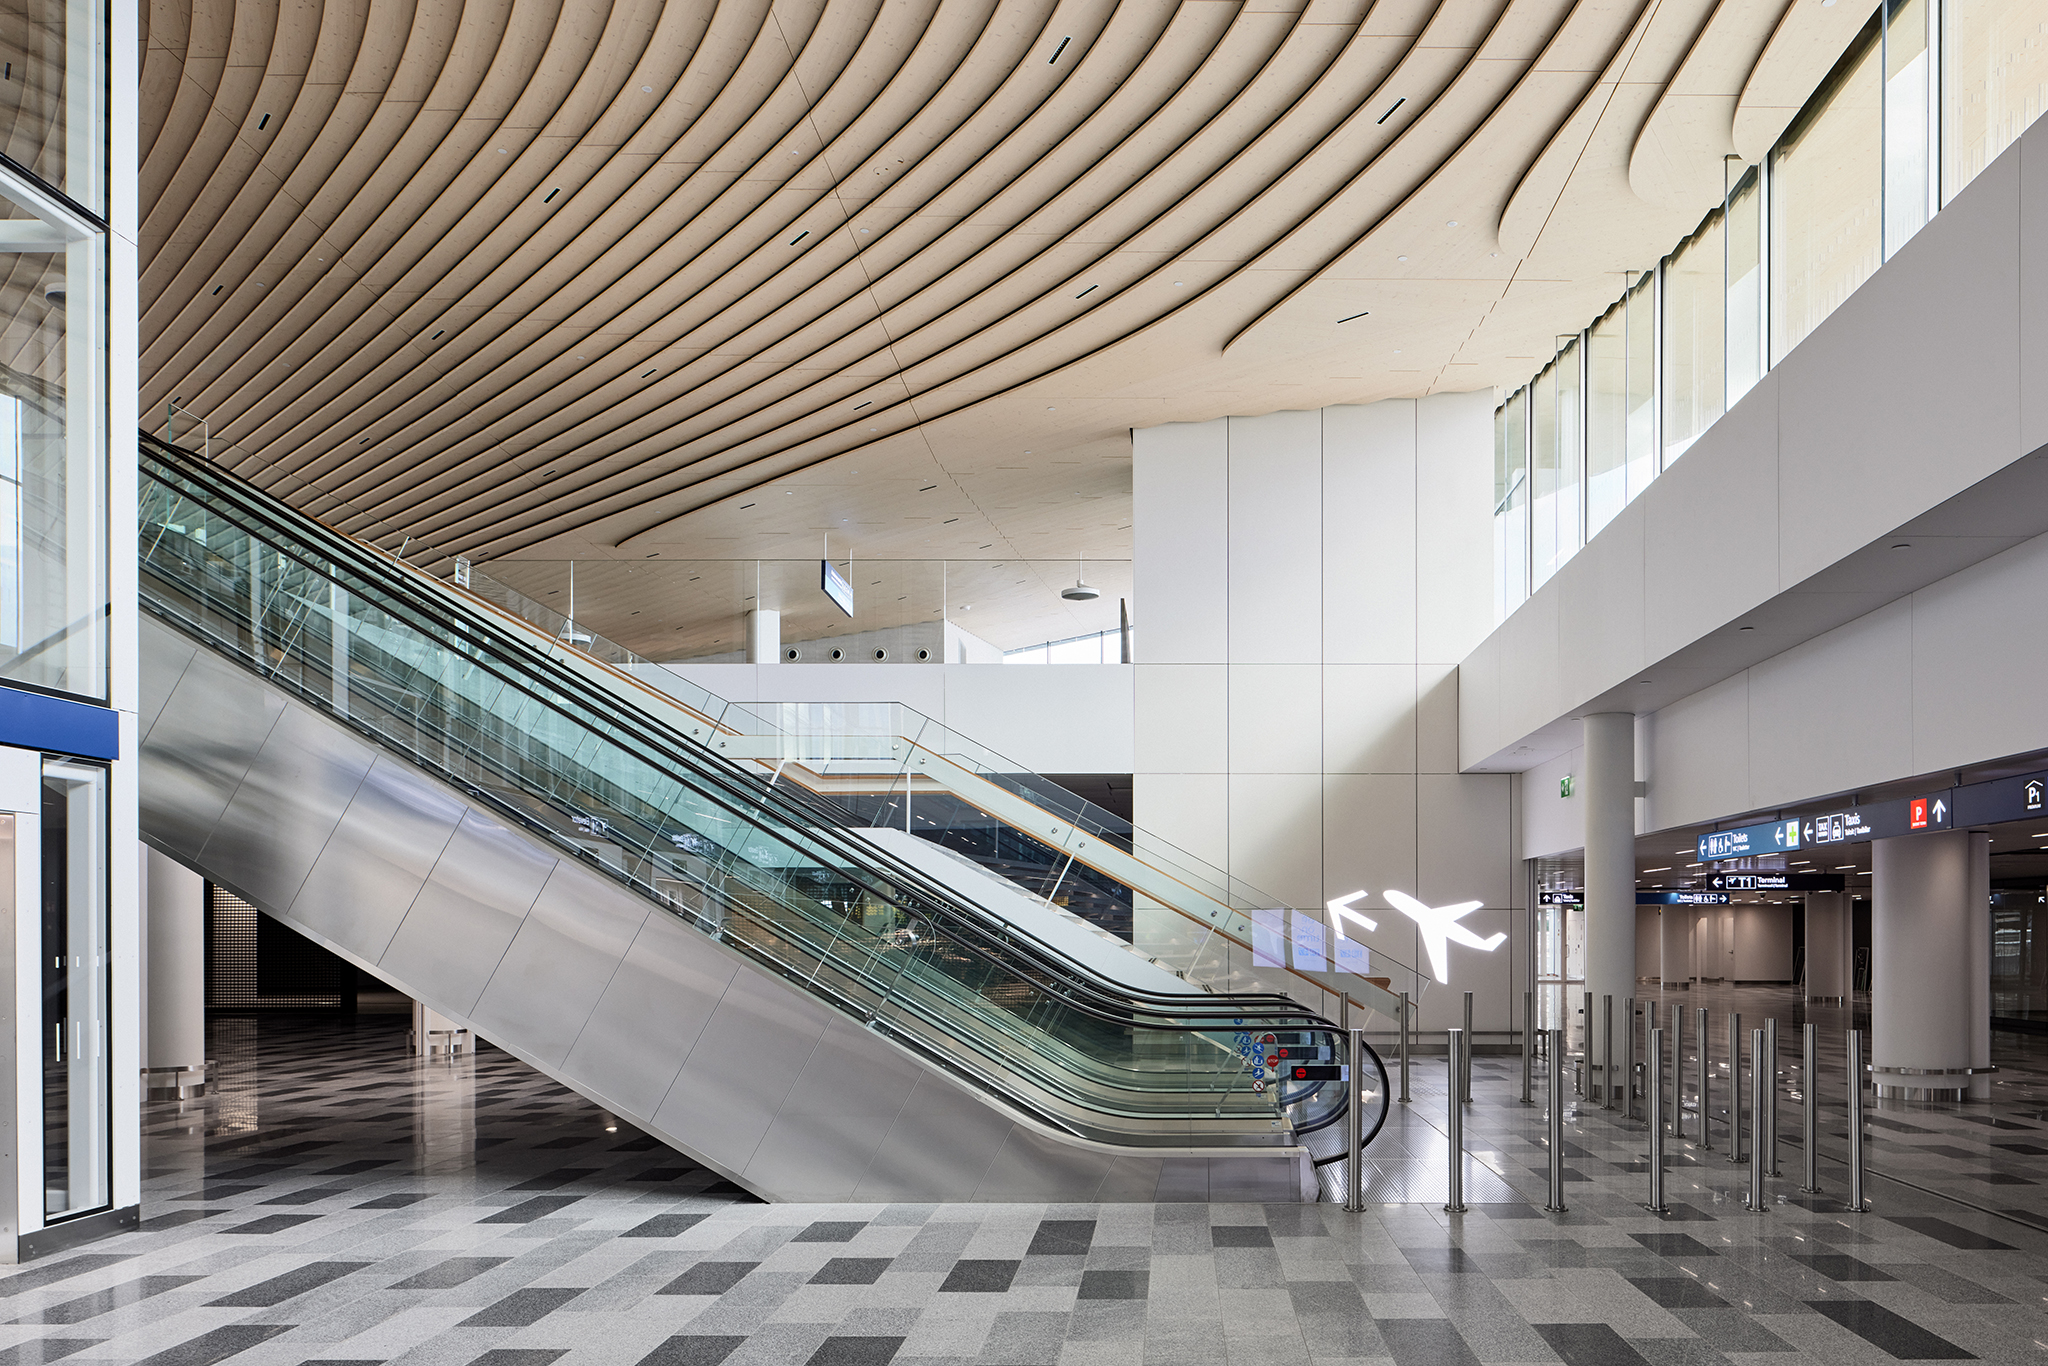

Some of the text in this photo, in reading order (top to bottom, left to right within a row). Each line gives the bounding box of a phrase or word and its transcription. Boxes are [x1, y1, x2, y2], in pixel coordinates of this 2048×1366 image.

[2028, 786, 2040, 803] P1
[1844, 812, 1861, 826] Taxis
[1915, 806, 1923, 821] P
[1732, 833, 1748, 844] Toilets
[1738, 876, 1752, 888] T1
